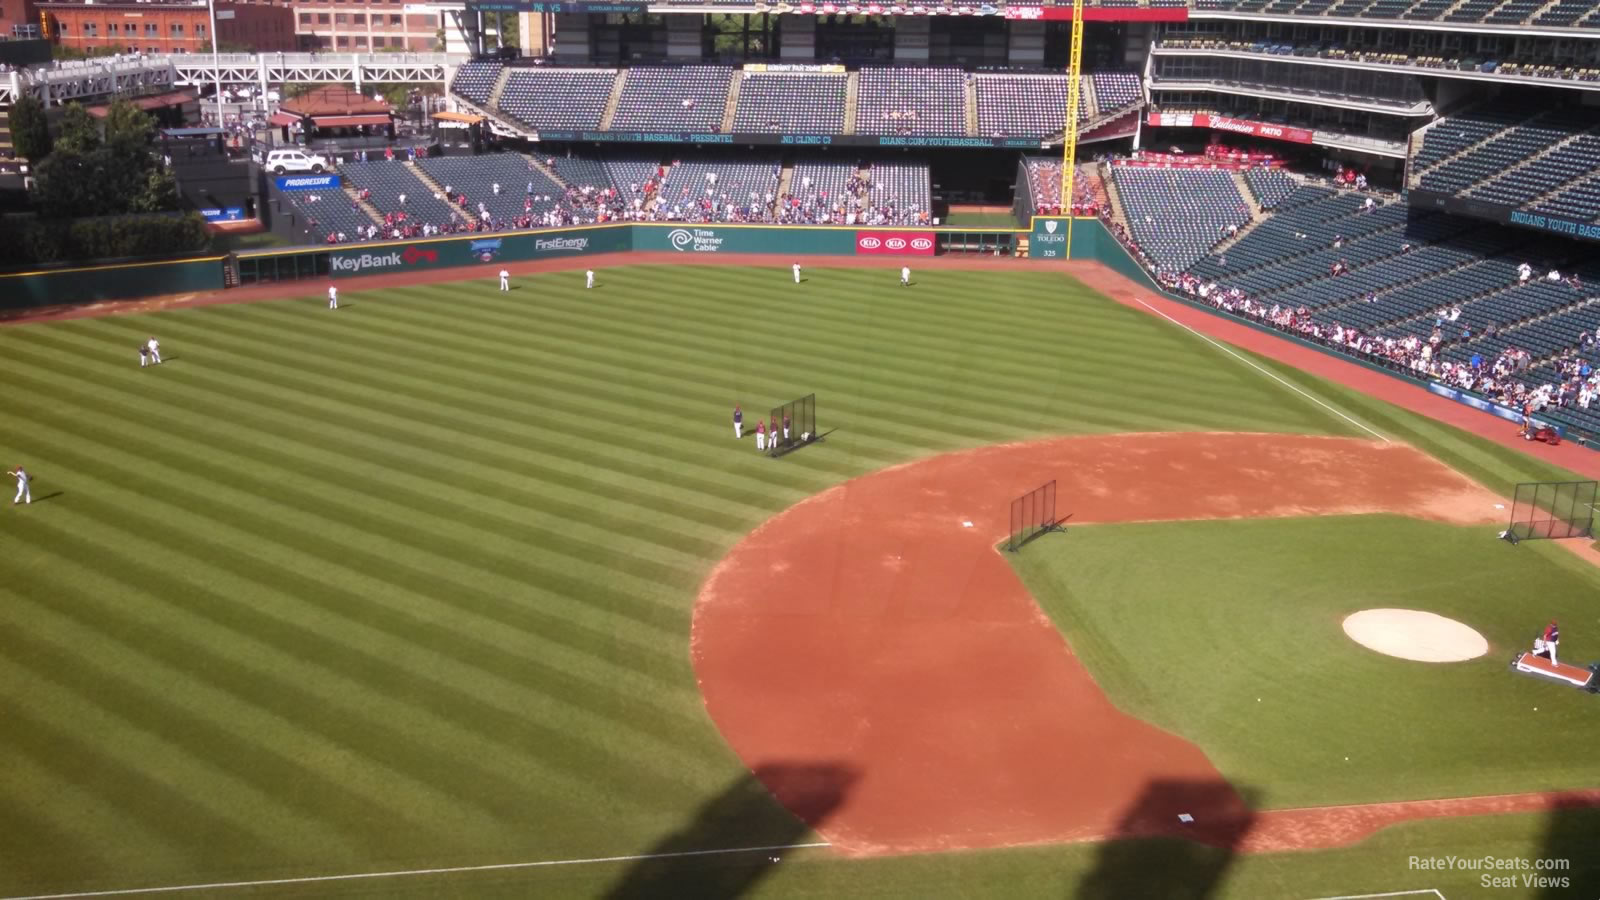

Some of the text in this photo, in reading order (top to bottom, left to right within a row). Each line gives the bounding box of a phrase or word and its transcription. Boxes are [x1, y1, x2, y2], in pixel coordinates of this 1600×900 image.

[1209, 115, 1254, 133] Budweiser
[1261, 126, 1282, 137] PATIO
[583, 132, 614, 141] INDIANS
[617, 133, 642, 141] YOUTH
[644, 133, 683, 142] BASEBALL
[781, 135, 793, 144] ND
[795, 136, 821, 144] CLINIC
[285, 177, 332, 187] PROGRESSIVE
[1510, 211, 1546, 228] INDIANS
[1547, 218, 1576, 234] YOUTH
[693, 229, 714, 237] Time
[535, 238, 589, 251] FirstEnergy
[332, 252, 401, 271] KeyBank
